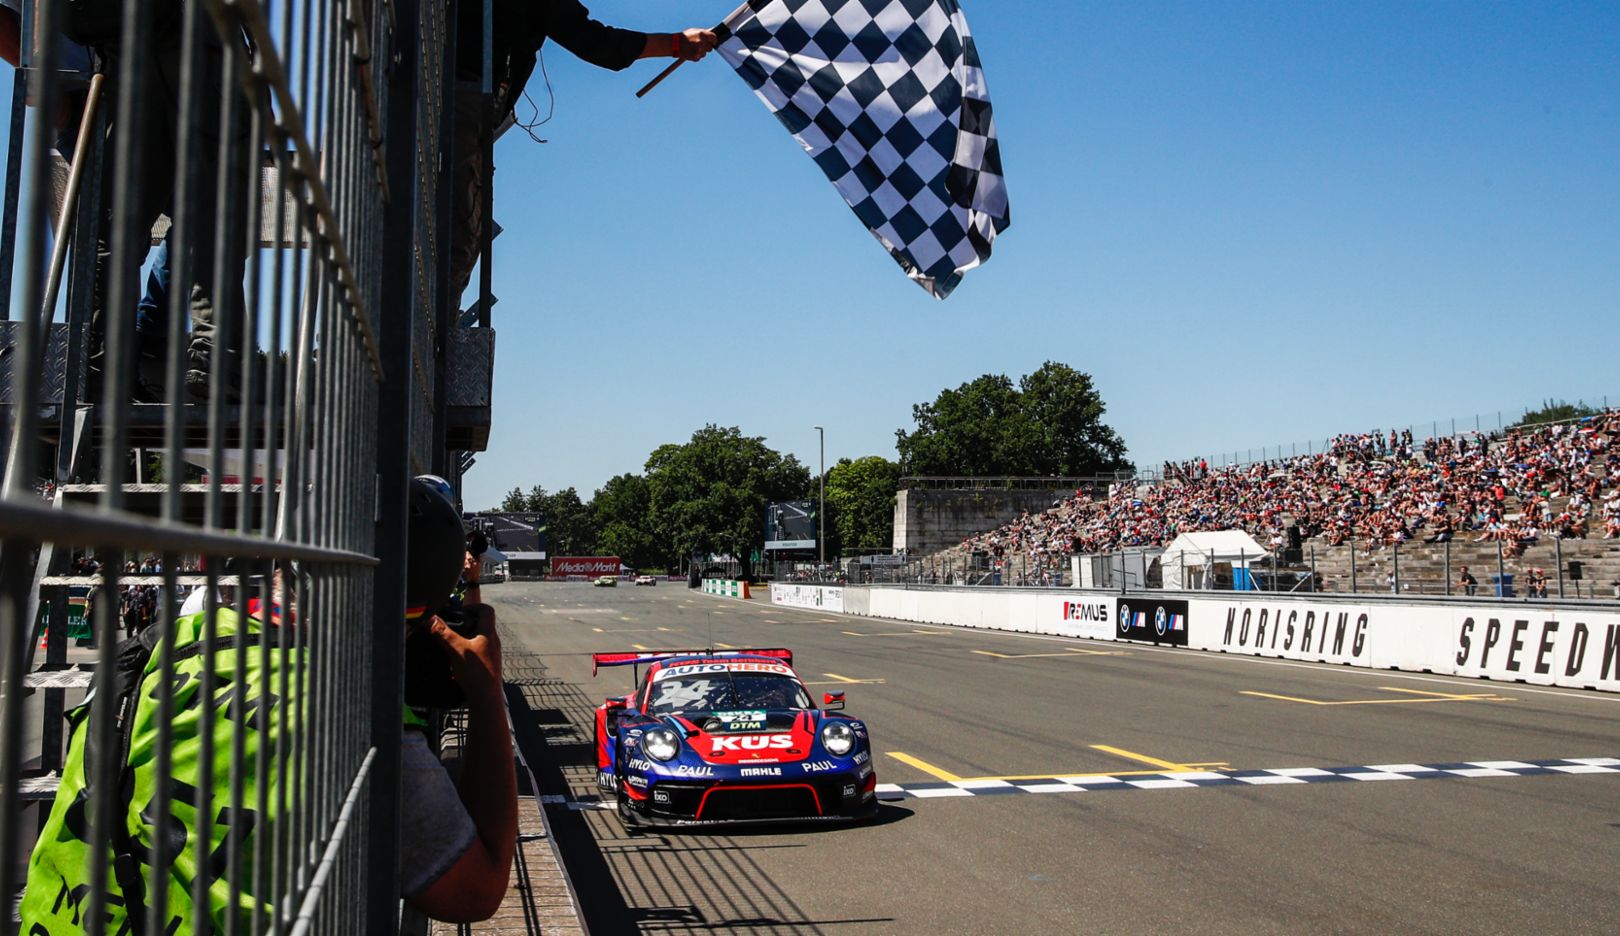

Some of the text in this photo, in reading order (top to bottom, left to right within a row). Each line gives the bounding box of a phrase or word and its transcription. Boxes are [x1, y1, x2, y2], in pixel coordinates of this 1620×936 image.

[1068, 603, 1108, 622] REMUS
[1223, 607, 1369, 657] NORISRING
[662, 664, 788, 678] AUTOHERO
[653, 679, 716, 709] 24
[730, 722, 761, 730] DTM
[710, 734, 795, 751] KÜS
[629, 758, 651, 771] HYLO
[677, 765, 714, 776] PAUL
[801, 760, 838, 773] PAUL
[740, 767, 782, 776] MAHLE
